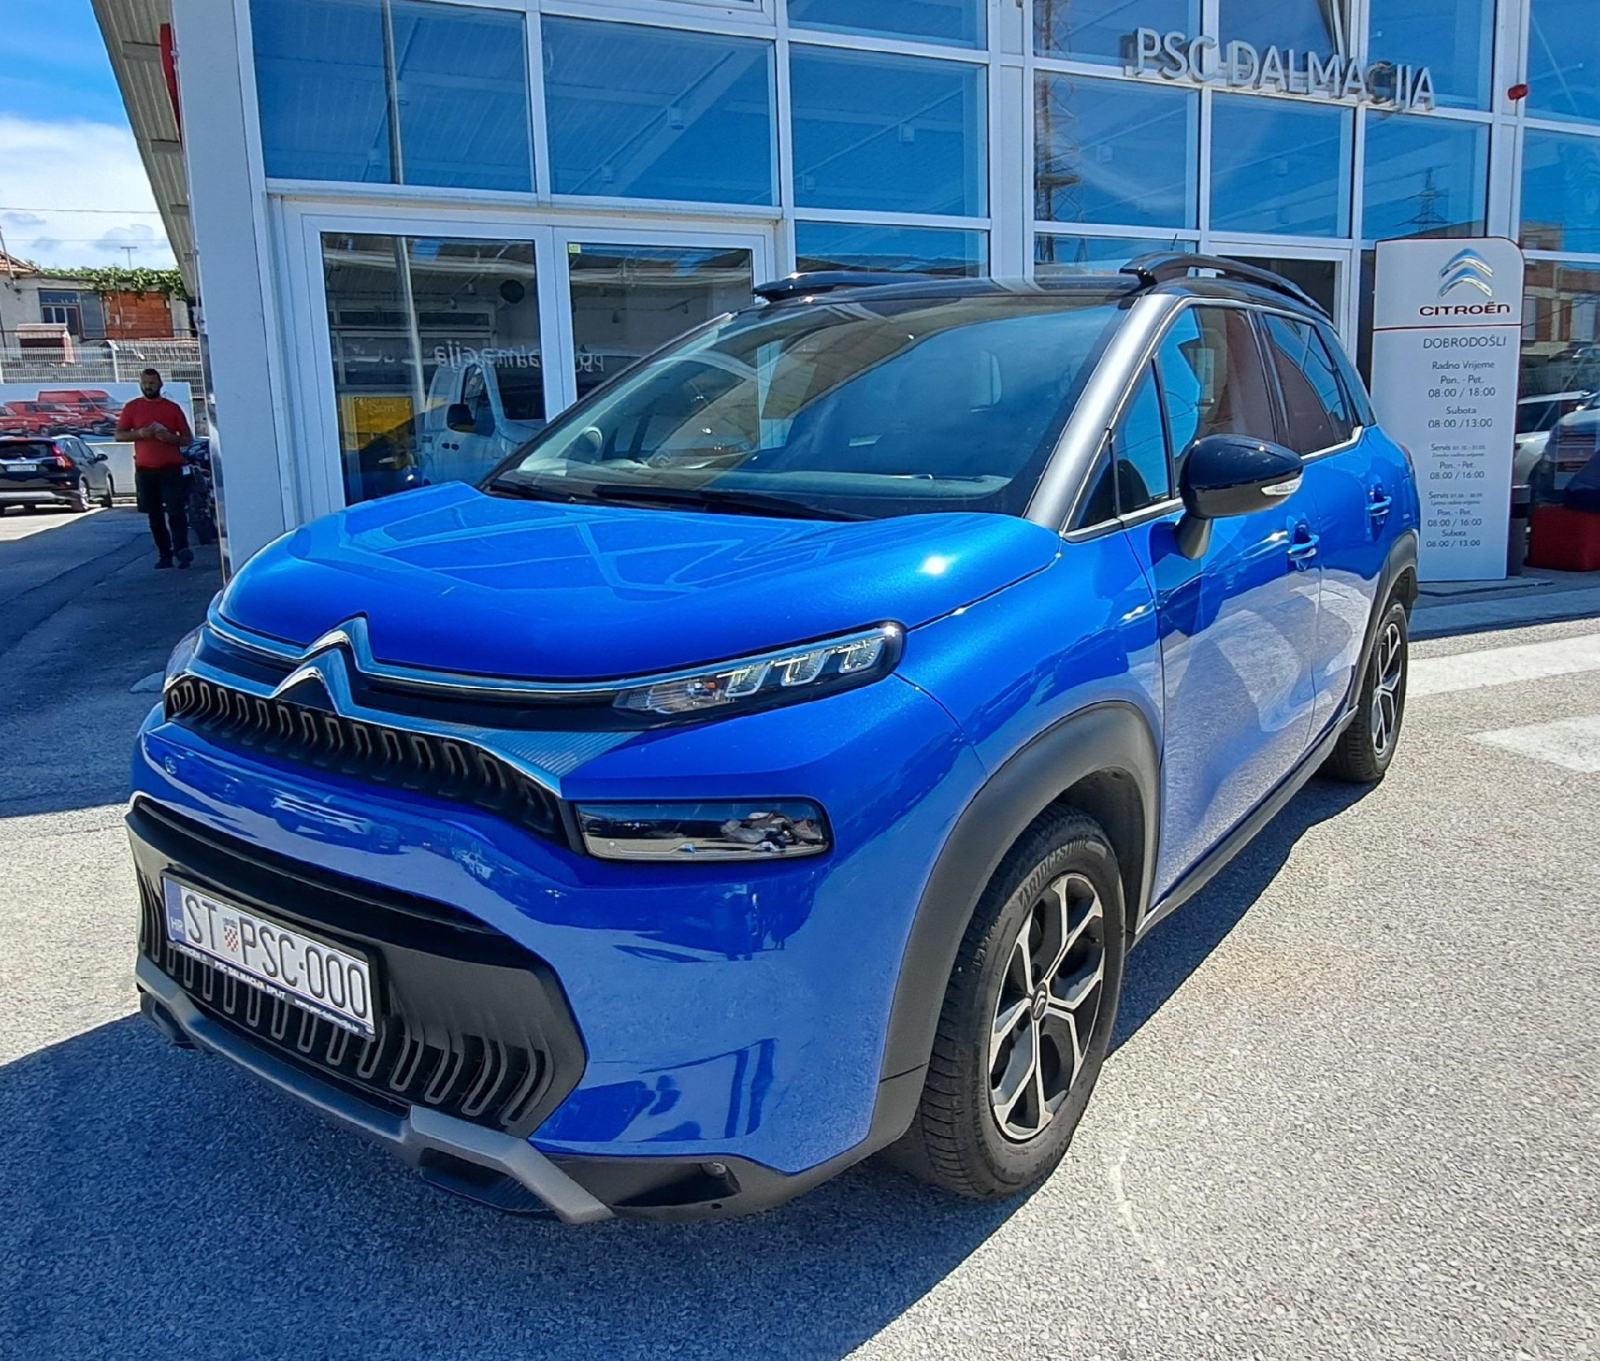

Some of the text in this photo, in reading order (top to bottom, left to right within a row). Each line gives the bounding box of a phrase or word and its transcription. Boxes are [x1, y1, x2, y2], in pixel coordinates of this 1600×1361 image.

[1136, 27, 1436, 114] PSC DALMACIJA
[1432, 361, 1495, 370] Radno Vrijeme
[1440, 375, 1459, 384] Pon.
[1467, 375, 1484, 384] Pet.
[1428, 388, 1457, 398] 08:00
[1469, 387, 1496, 396] 18:00
[1446, 406, 1477, 414] Subota
[171, 917, 185, 934] HR
[184, 893, 217, 950] ST
